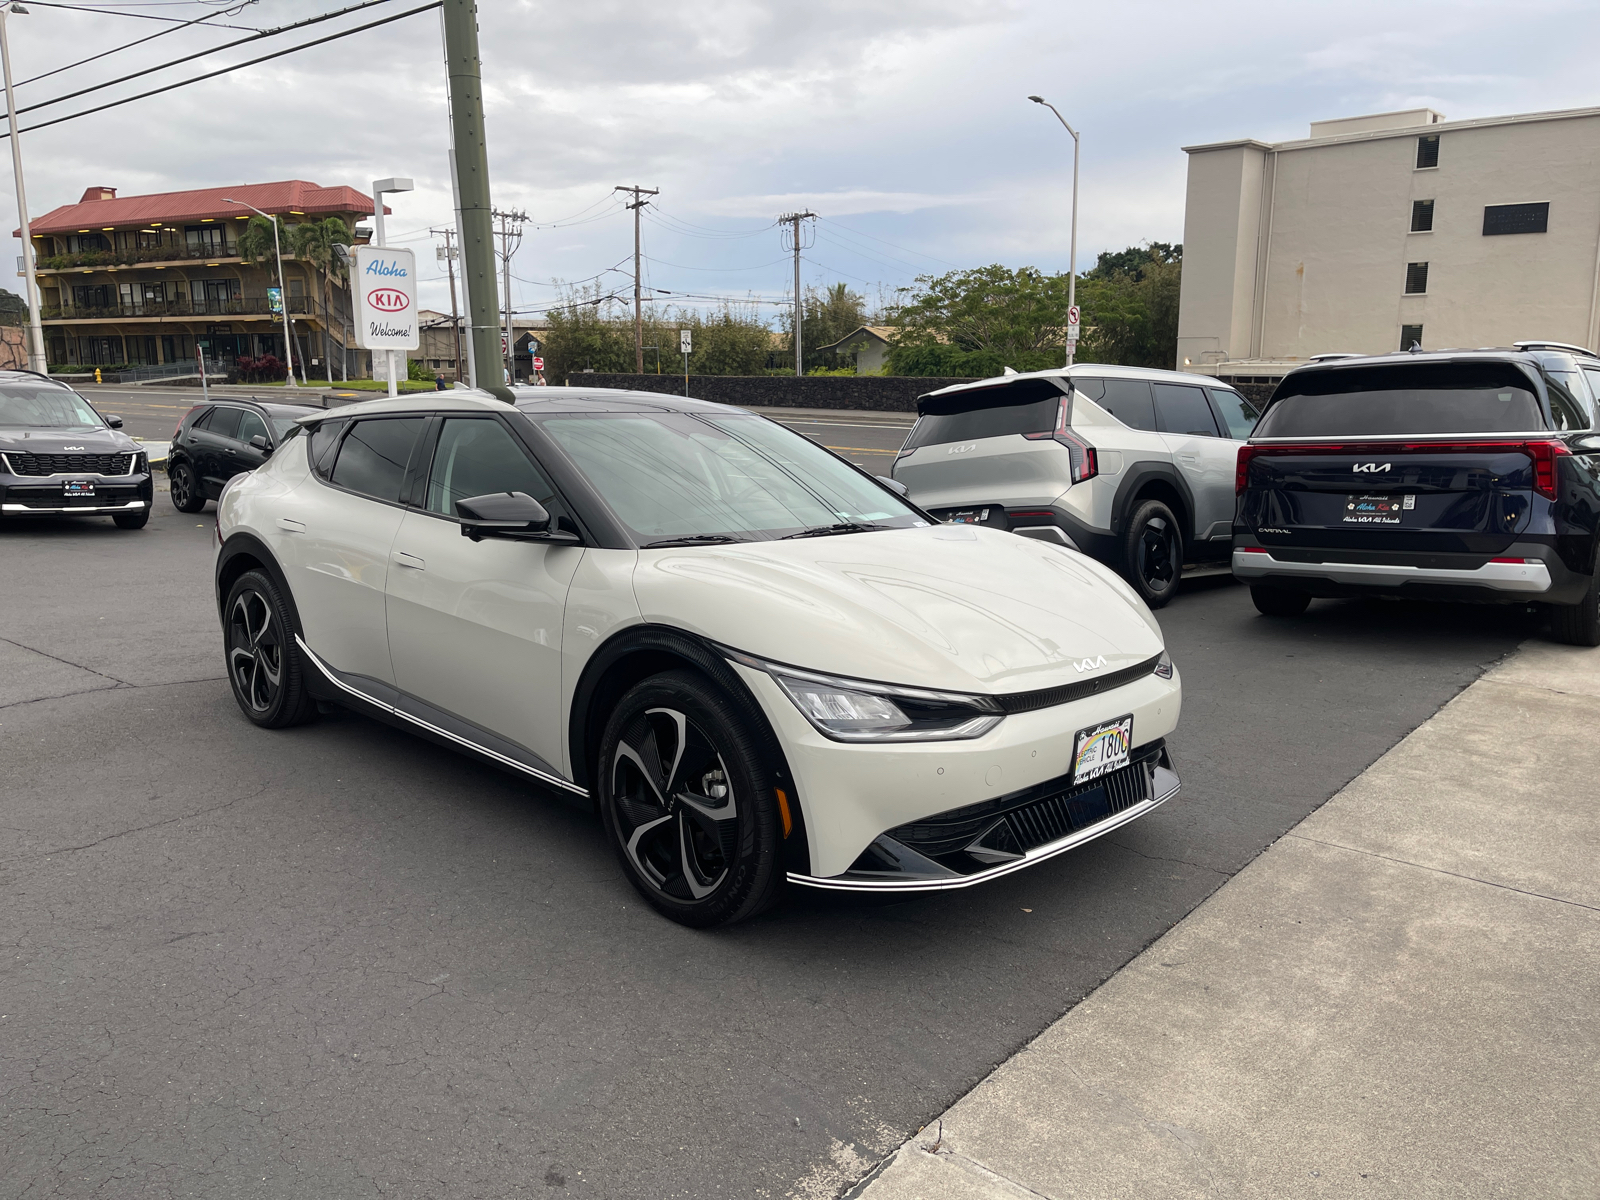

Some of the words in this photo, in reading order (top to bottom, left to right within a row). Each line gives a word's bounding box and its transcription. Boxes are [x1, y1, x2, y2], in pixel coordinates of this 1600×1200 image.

[366, 260, 408, 277] Aloha
[375, 293, 403, 307] KIA
[370, 321, 412, 337] Welcome!
[1353, 463, 1391, 473] KIA
[1356, 503, 1376, 511] Aloha
[1073, 655, 1107, 672] KIA
[1092, 721, 1120, 736] Hawaii
